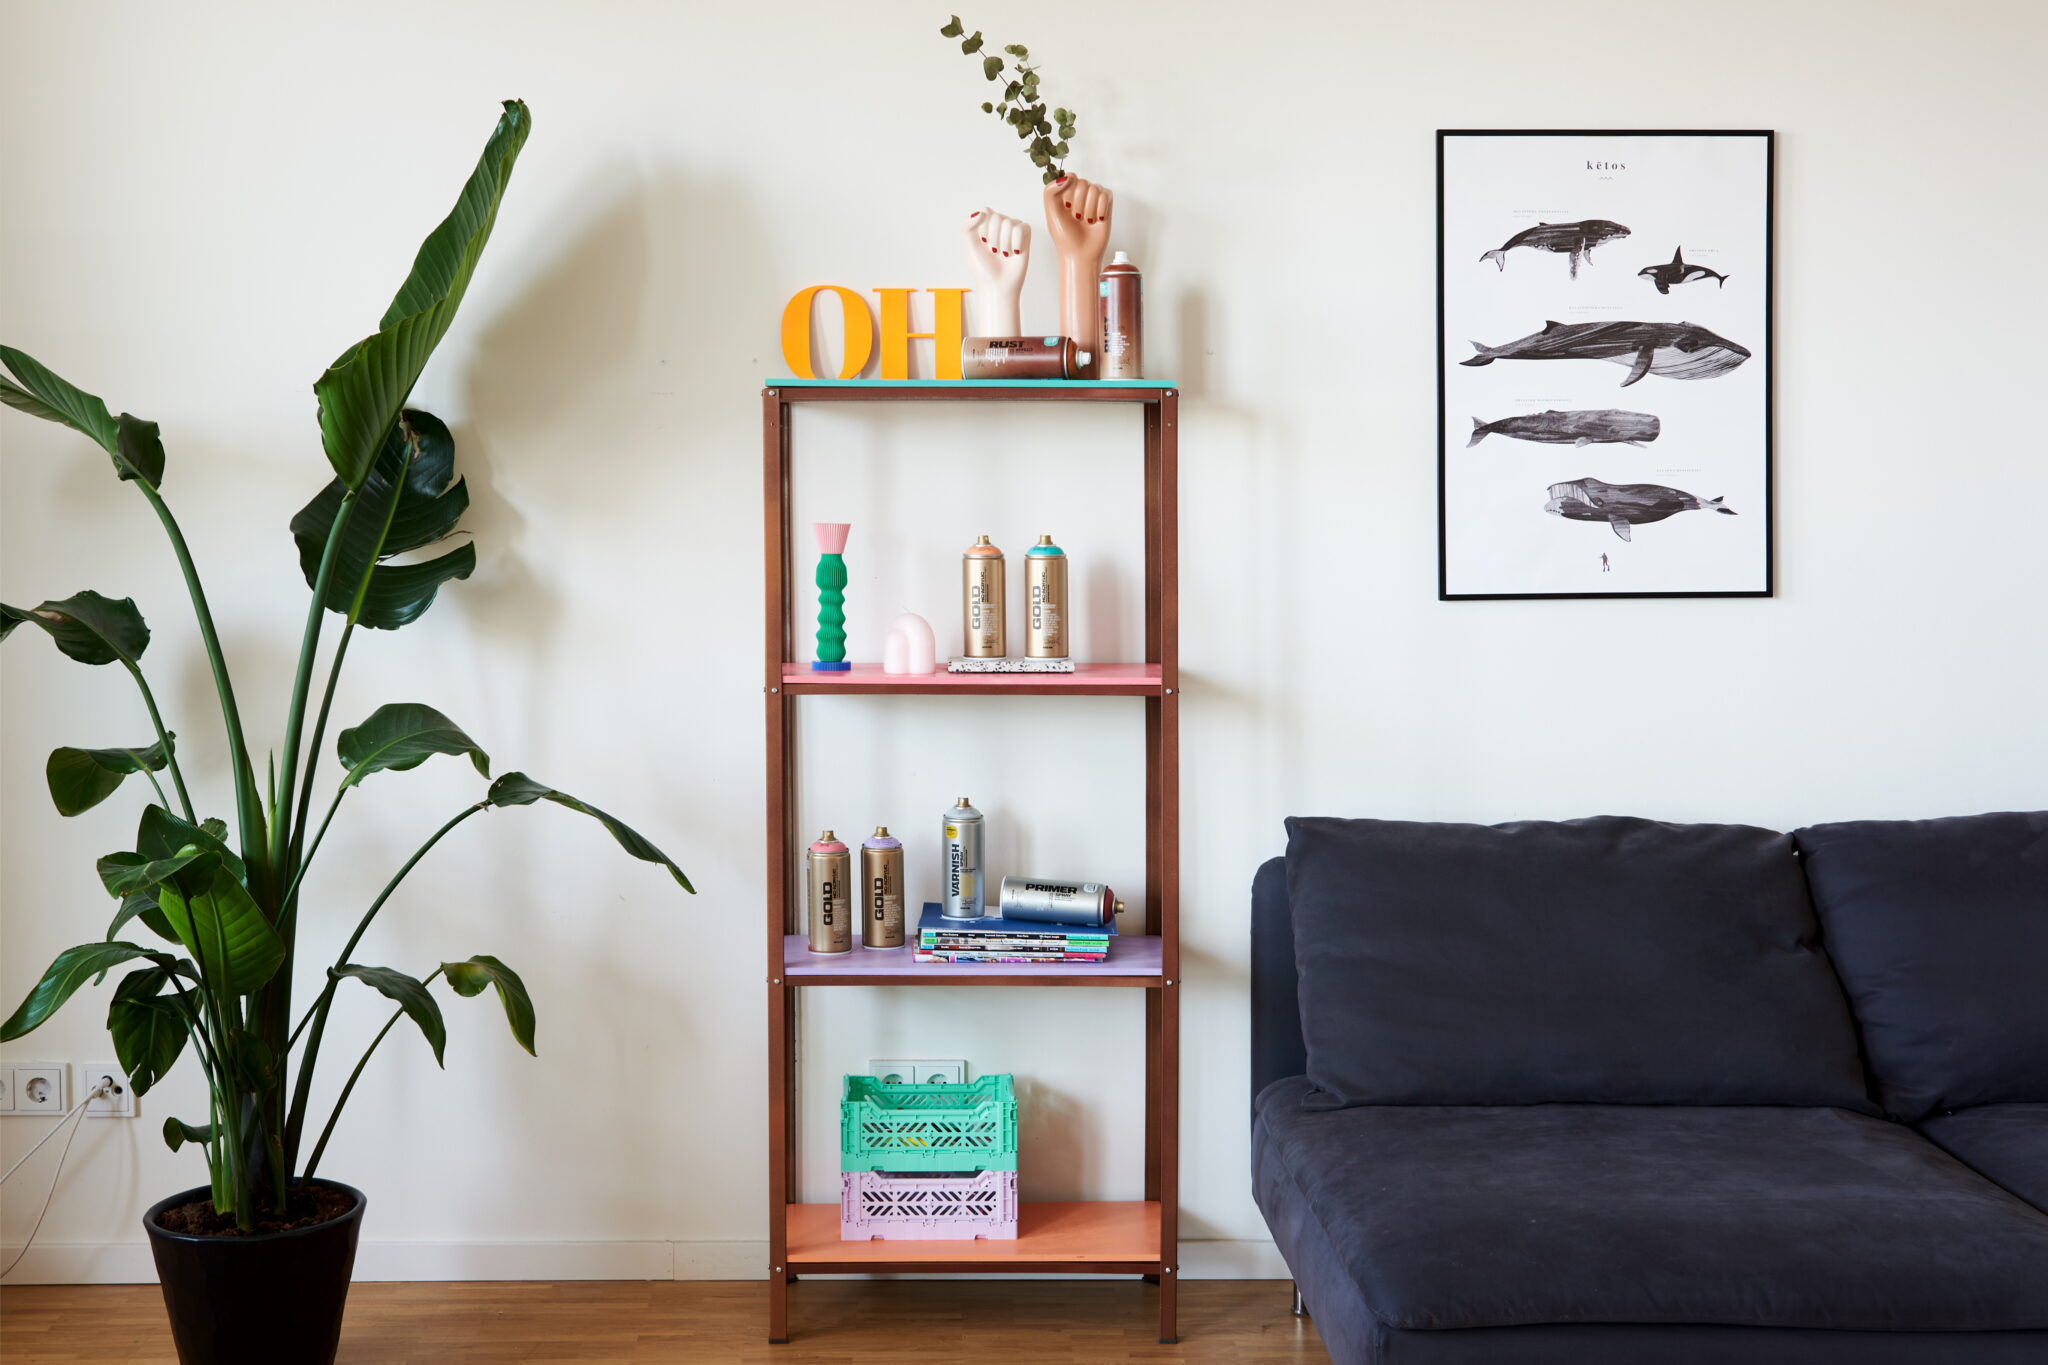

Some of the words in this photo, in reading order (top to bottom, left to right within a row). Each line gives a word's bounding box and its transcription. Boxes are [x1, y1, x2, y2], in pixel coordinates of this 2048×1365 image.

[1586, 160, 1626, 170] kētos
[780, 285, 971, 380] OH
[972, 586, 981, 629] GOLD
[1033, 586, 1041, 629] GOLD
[952, 844, 960, 897] VARNISH
[1025, 883, 1078, 894] PRIMER
[823, 882, 833, 926] GOLD
[874, 877, 884, 921] GOLD
